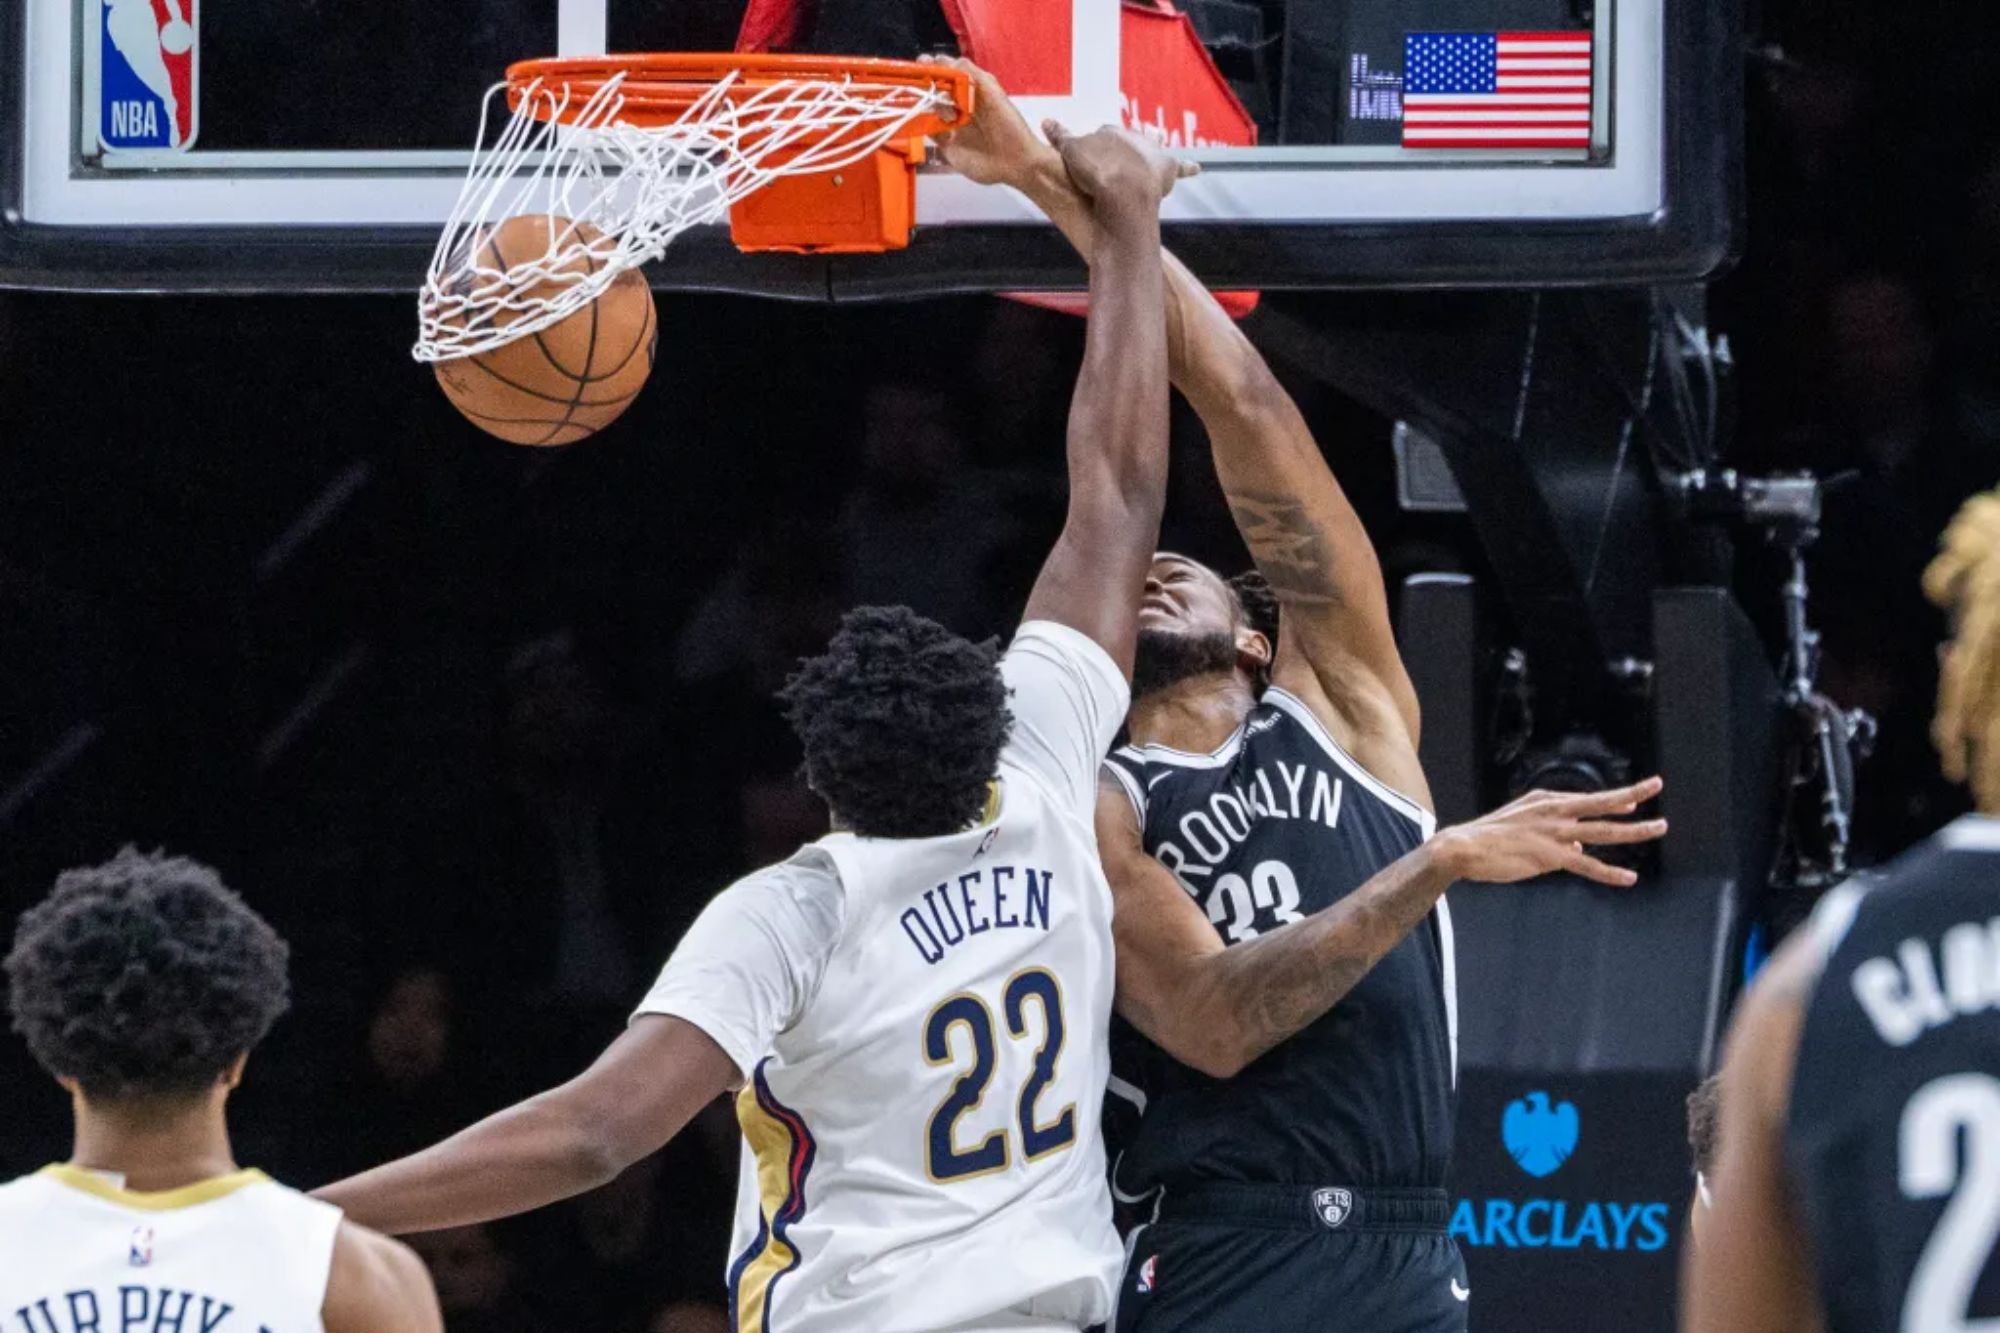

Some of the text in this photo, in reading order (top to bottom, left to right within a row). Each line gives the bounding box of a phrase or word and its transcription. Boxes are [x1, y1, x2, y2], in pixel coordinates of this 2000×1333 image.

[111, 100, 159, 138] NBA
[1155, 760, 1343, 897] ROOKLYN
[900, 866, 1053, 965] QUEEN
[1204, 859, 1306, 943] 33
[921, 965, 1077, 1185] 22
[1317, 1192, 1349, 1207] NETS
[1448, 1198, 1669, 1251] ARCLAYS
[1898, 1071, 2000, 1333] 2
[0, 1286, 235, 1333] URPHY
